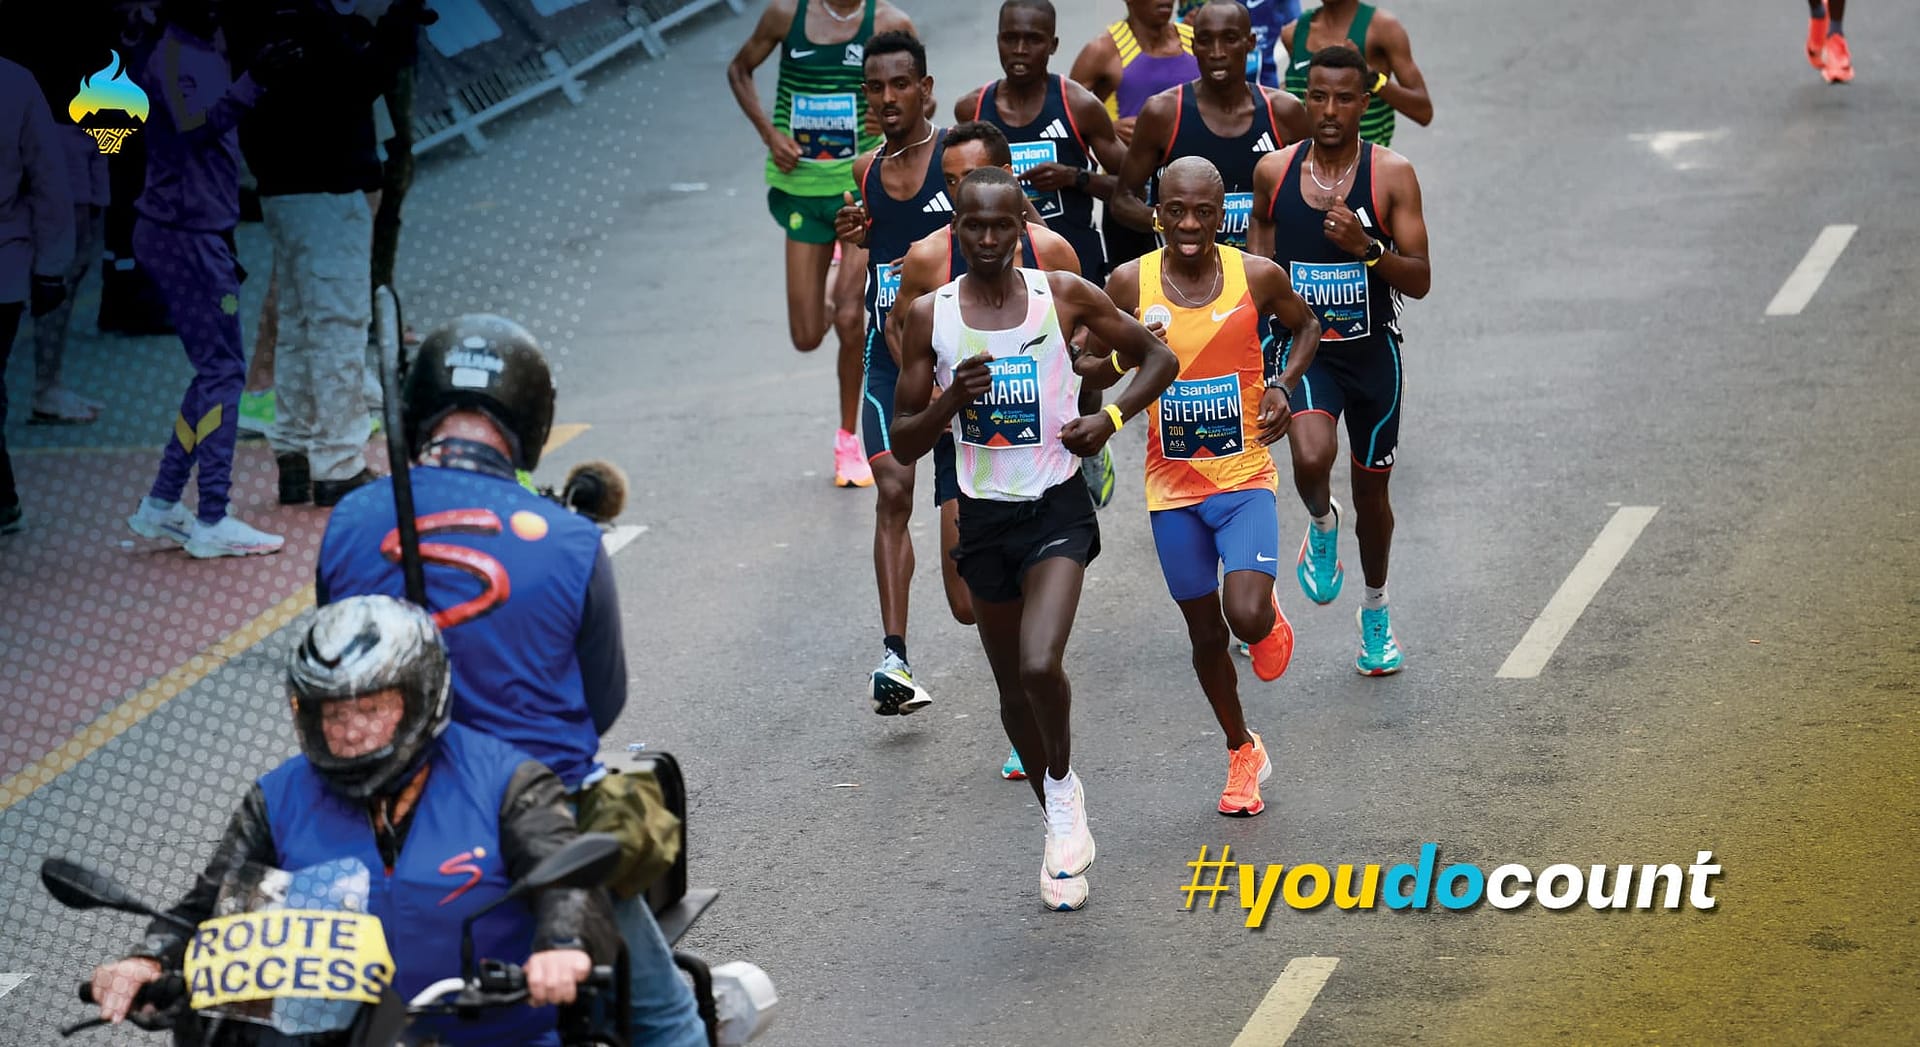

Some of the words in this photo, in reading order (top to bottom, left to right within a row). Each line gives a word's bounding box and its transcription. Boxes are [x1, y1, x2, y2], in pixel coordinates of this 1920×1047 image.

[808, 98, 851, 111] Sanlam
[1011, 148, 1050, 161] anlam
[1222, 197, 1254, 210] Sanla
[1311, 268, 1361, 280] Sanlam
[1295, 281, 1366, 306] ZEWUDE
[989, 361, 1032, 376] anlam
[973, 378, 1037, 406] NARD
[1180, 383, 1233, 396] Sanlam
[1163, 395, 1239, 423] STEPHEN
[1168, 425, 1185, 437] 200
[1169, 440, 1186, 448] ASA
[192, 917, 358, 960] ROUTE
[191, 957, 388, 998] ACCESS
